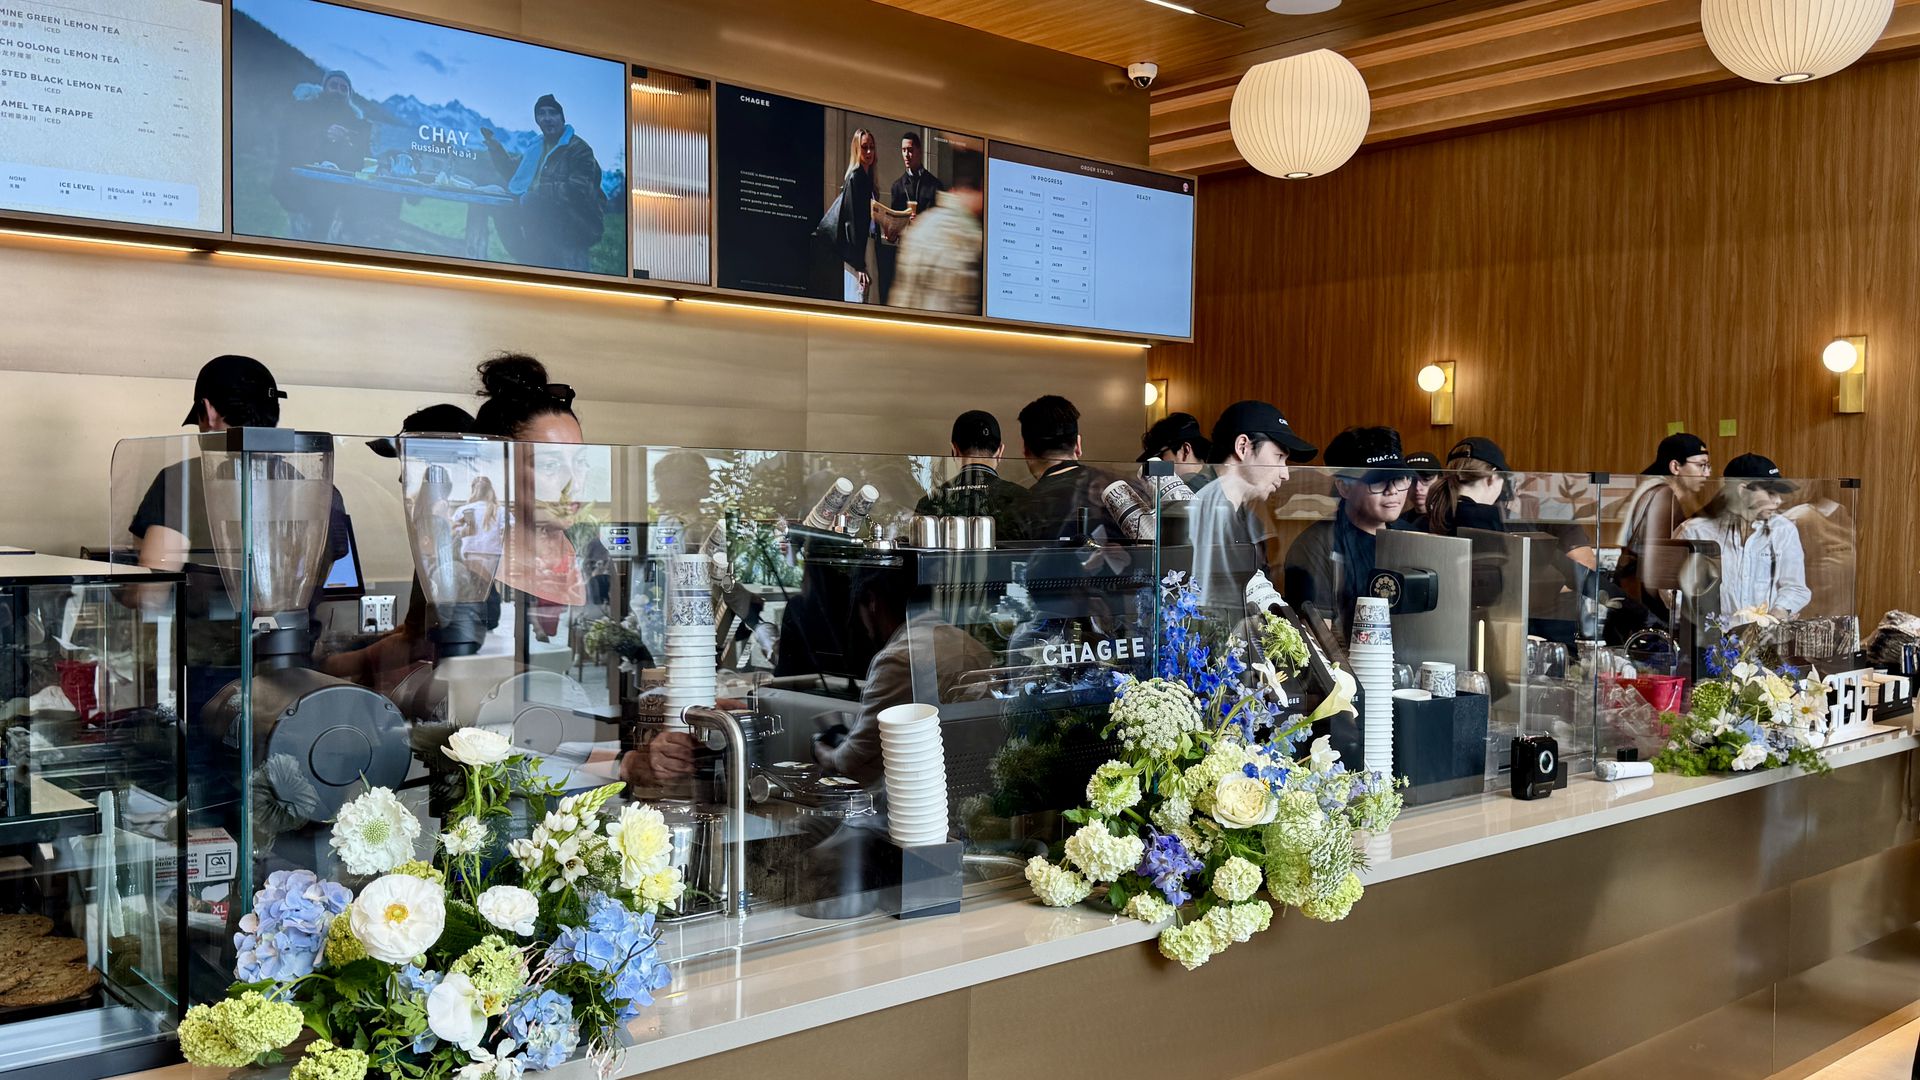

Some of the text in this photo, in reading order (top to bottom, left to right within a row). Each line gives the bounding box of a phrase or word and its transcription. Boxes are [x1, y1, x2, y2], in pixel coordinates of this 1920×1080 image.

[27, 13, 60, 25] GREEN
[64, 19, 98, 31] LEMON
[102, 25, 120, 35] TEA
[44, 26, 61, 34] ICED
[17, 41, 60, 54] OOLONG
[64, 48, 98, 60] LEMON
[102, 55, 120, 64] TEA
[44, 57, 61, 65] ICED
[0, 69, 123, 94] STED BLACK LEMON TEA
[44, 87, 61, 95] ICED
[740, 95, 770, 107] CHAGEE
[1, 99, 94, 119] AMEL TEA FRAPPE
[44, 117, 61, 125] ICED
[418, 124, 469, 146] CHAY
[1080, 164, 1114, 176] ORDER STATUS
[1038, 176, 1063, 186] PROGRESS
[73, 183, 95, 191] LEVEL
[107, 187, 135, 195] REGULAR
[1136, 193, 1151, 201] READY
[1042, 637, 1146, 666] CHAGEE
[1277, 697, 1300, 705] CGEE
[213, 904, 227, 914] XL
